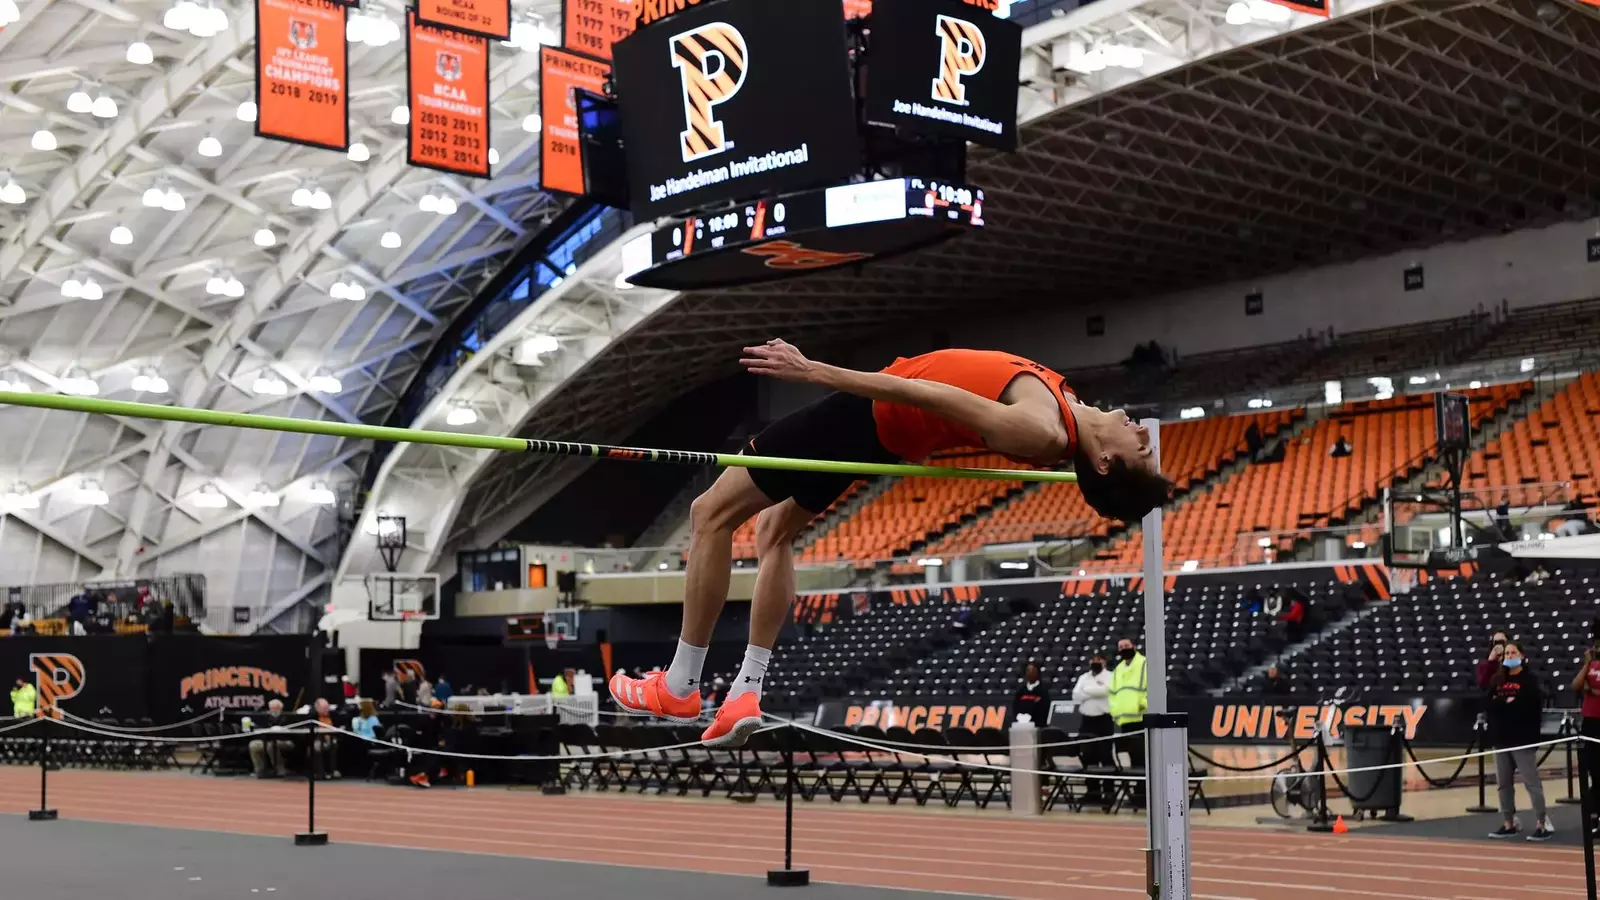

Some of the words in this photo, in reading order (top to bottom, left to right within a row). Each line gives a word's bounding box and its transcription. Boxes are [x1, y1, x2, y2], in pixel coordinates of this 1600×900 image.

[264, 63, 341, 92] CHAMPIONS
[271, 82, 300, 99] 2018
[308, 90, 338, 106] 2019
[893, 99, 911, 115] Joe
[650, 184, 667, 201] Joe
[666, 165, 729, 196] Handelman
[729, 143, 809, 178] Invitational
[708, 212, 739, 233] 10:00
[773, 202, 786, 223] 0
[672, 227, 682, 247] 0
[180, 665, 289, 700] PRINCETON
[204, 694, 266, 708] ATHLETICS
[845, 705, 1007, 734] PRINCETON
[1210, 704, 1428, 740] UNIVERSITY
